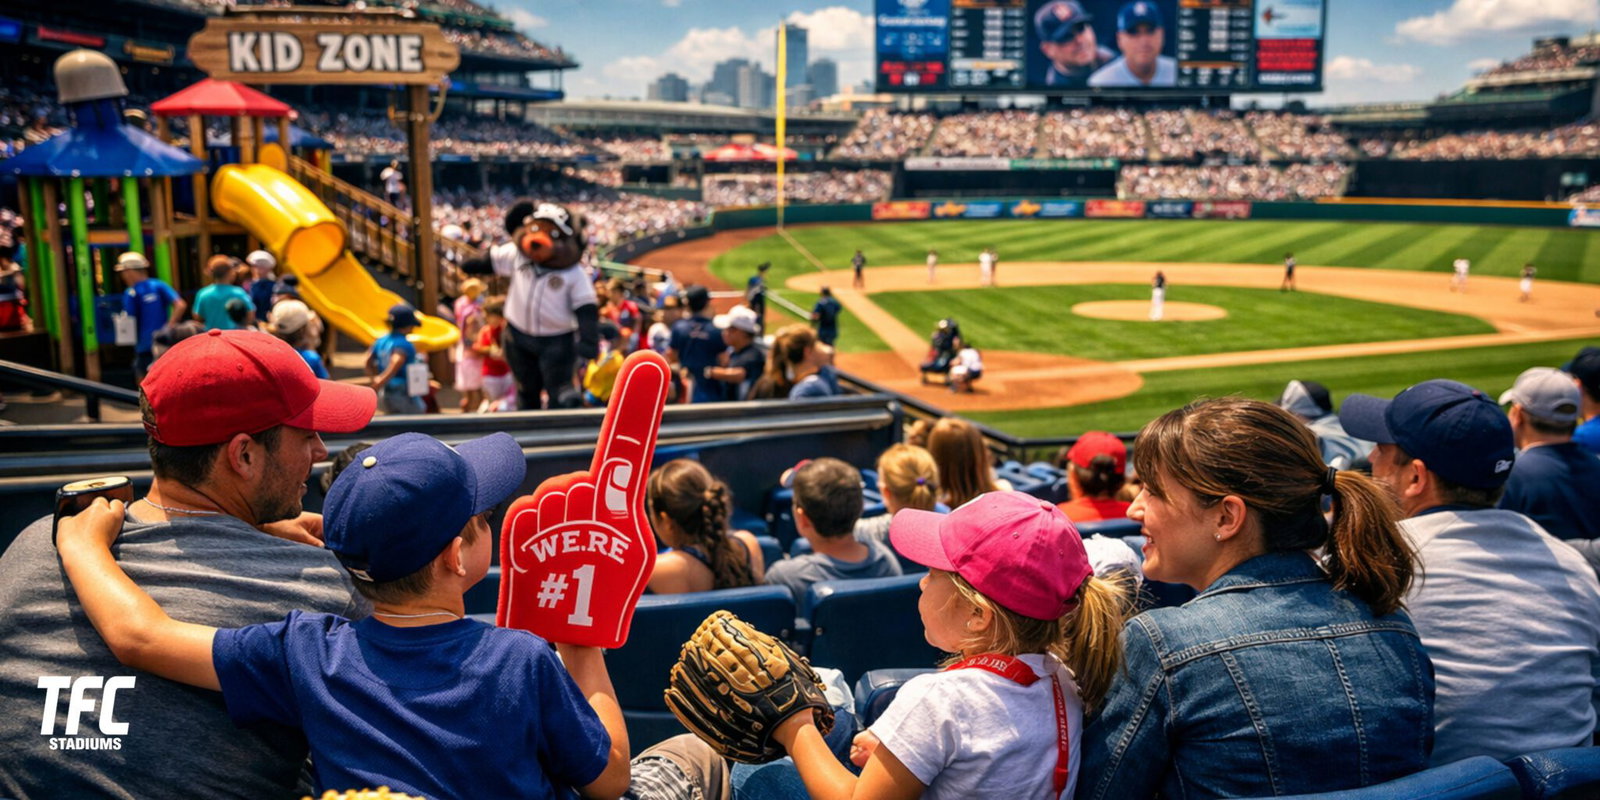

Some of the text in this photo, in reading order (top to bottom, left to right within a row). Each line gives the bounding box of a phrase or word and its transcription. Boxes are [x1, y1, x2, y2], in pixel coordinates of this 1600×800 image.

[229, 32, 423, 73] KID ZONE
[536, 564, 596, 627] #1
